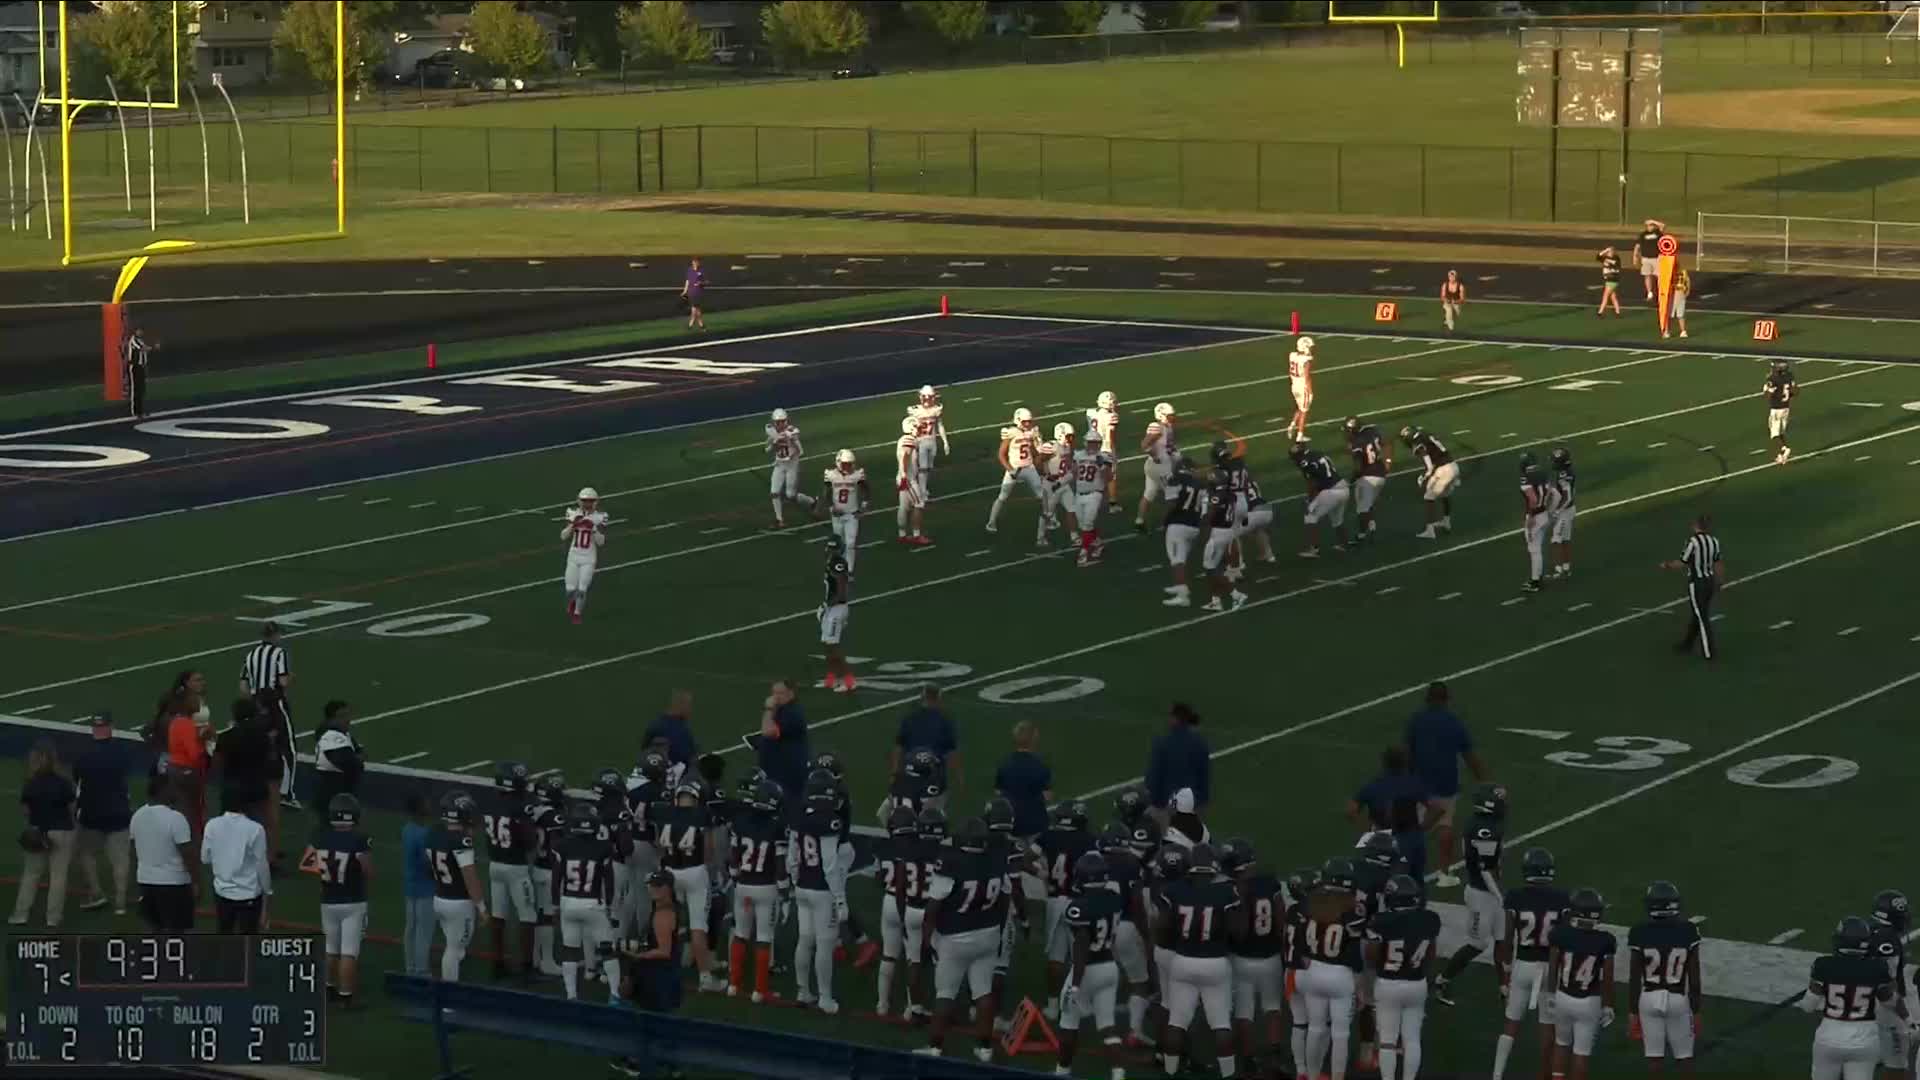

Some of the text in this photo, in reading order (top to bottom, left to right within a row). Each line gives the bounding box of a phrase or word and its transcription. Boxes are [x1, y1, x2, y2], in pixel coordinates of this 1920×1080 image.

[1755, 320, 1773, 340] 10
[1078, 464, 1098, 482] 28
[575, 529, 591, 549] 10
[659, 824, 697, 857] 44
[740, 837, 770, 873] 21
[565, 860, 597, 893] 51
[957, 877, 1002, 914] 79
[1178, 905, 1214, 942] 71
[1305, 919, 1344, 959] 40
[1383, 938, 1431, 973] 54
[1561, 950, 1598, 991] 14
[1643, 948, 1688, 985] 20
[1825, 984, 1874, 1019] 55
